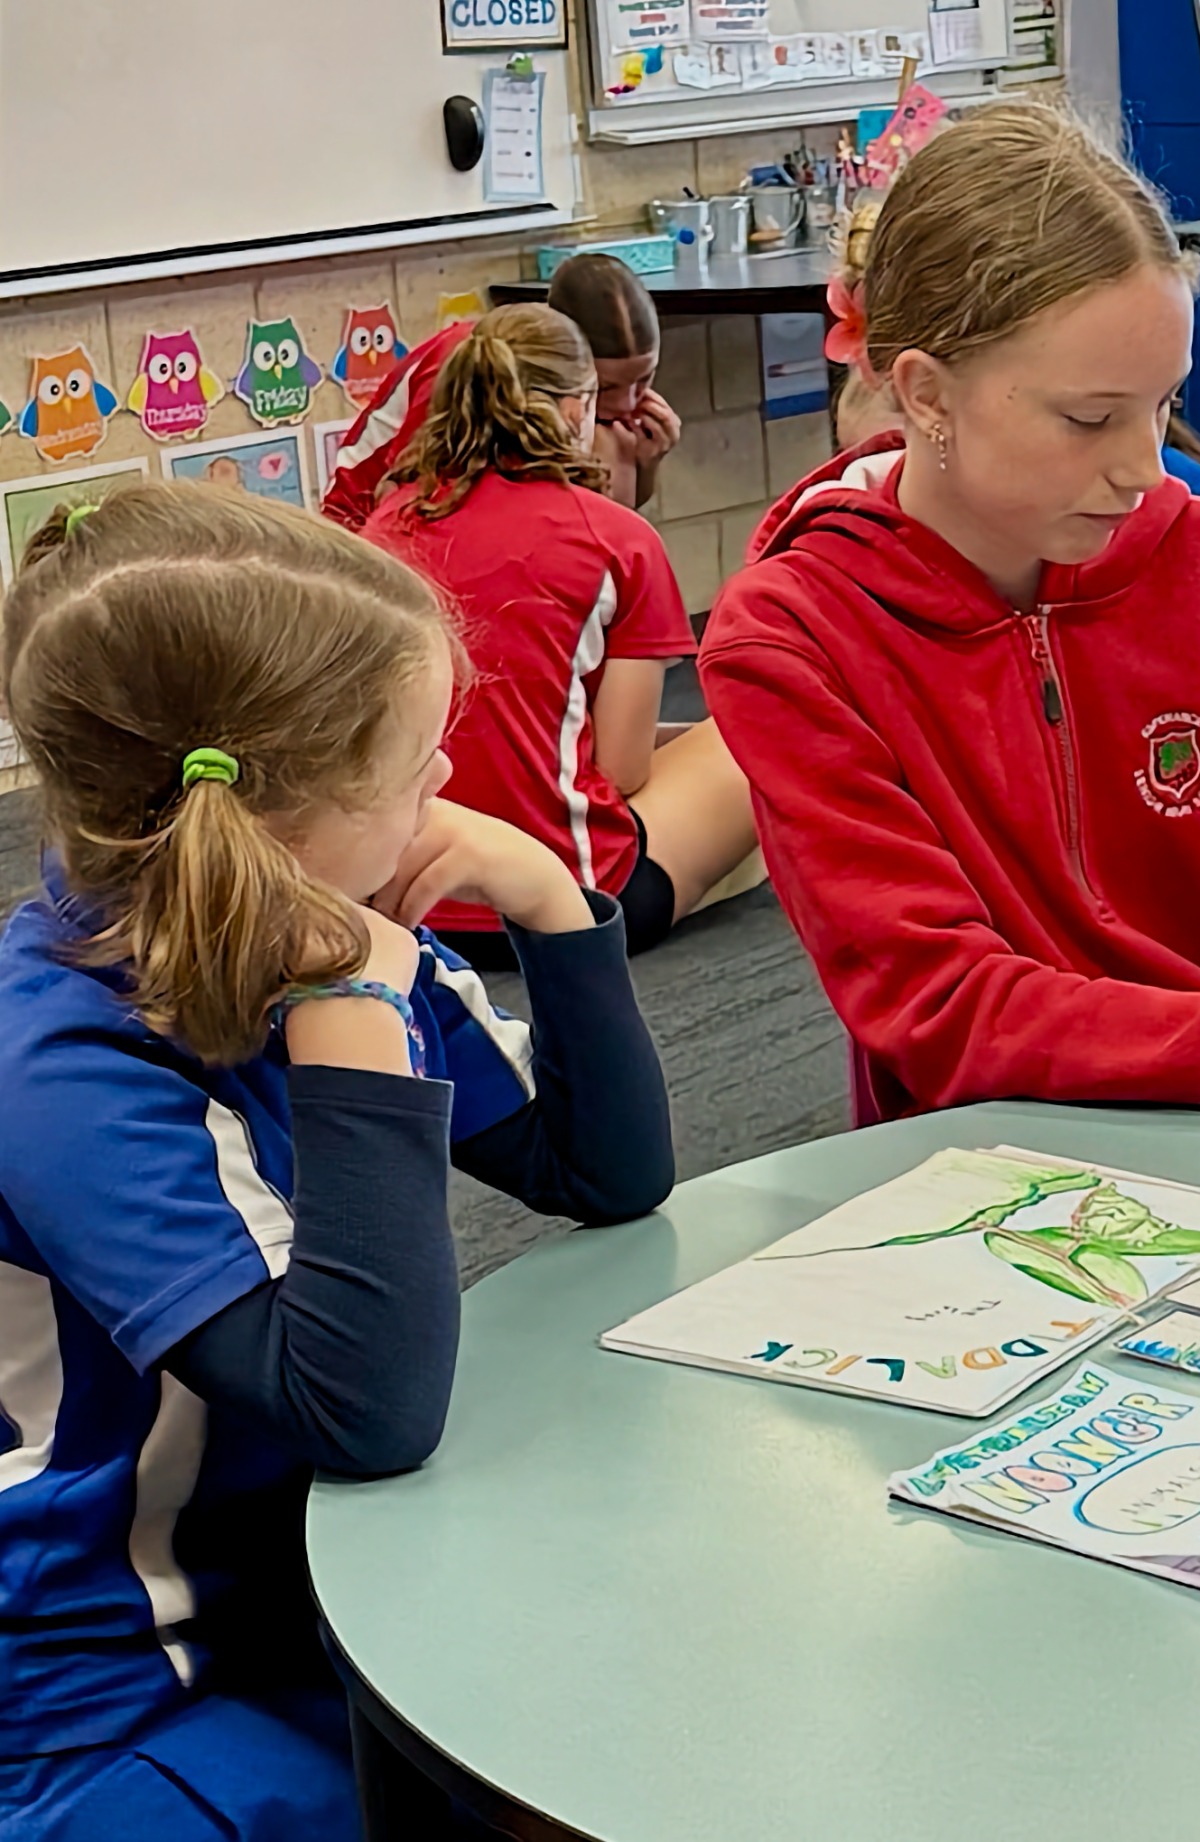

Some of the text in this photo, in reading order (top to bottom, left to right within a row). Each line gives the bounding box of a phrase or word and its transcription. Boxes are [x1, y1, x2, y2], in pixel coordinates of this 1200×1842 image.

[451, 0, 556, 28] CLOSED
[254, 385, 309, 411] Friday
[145, 402, 207, 425] Thursday
